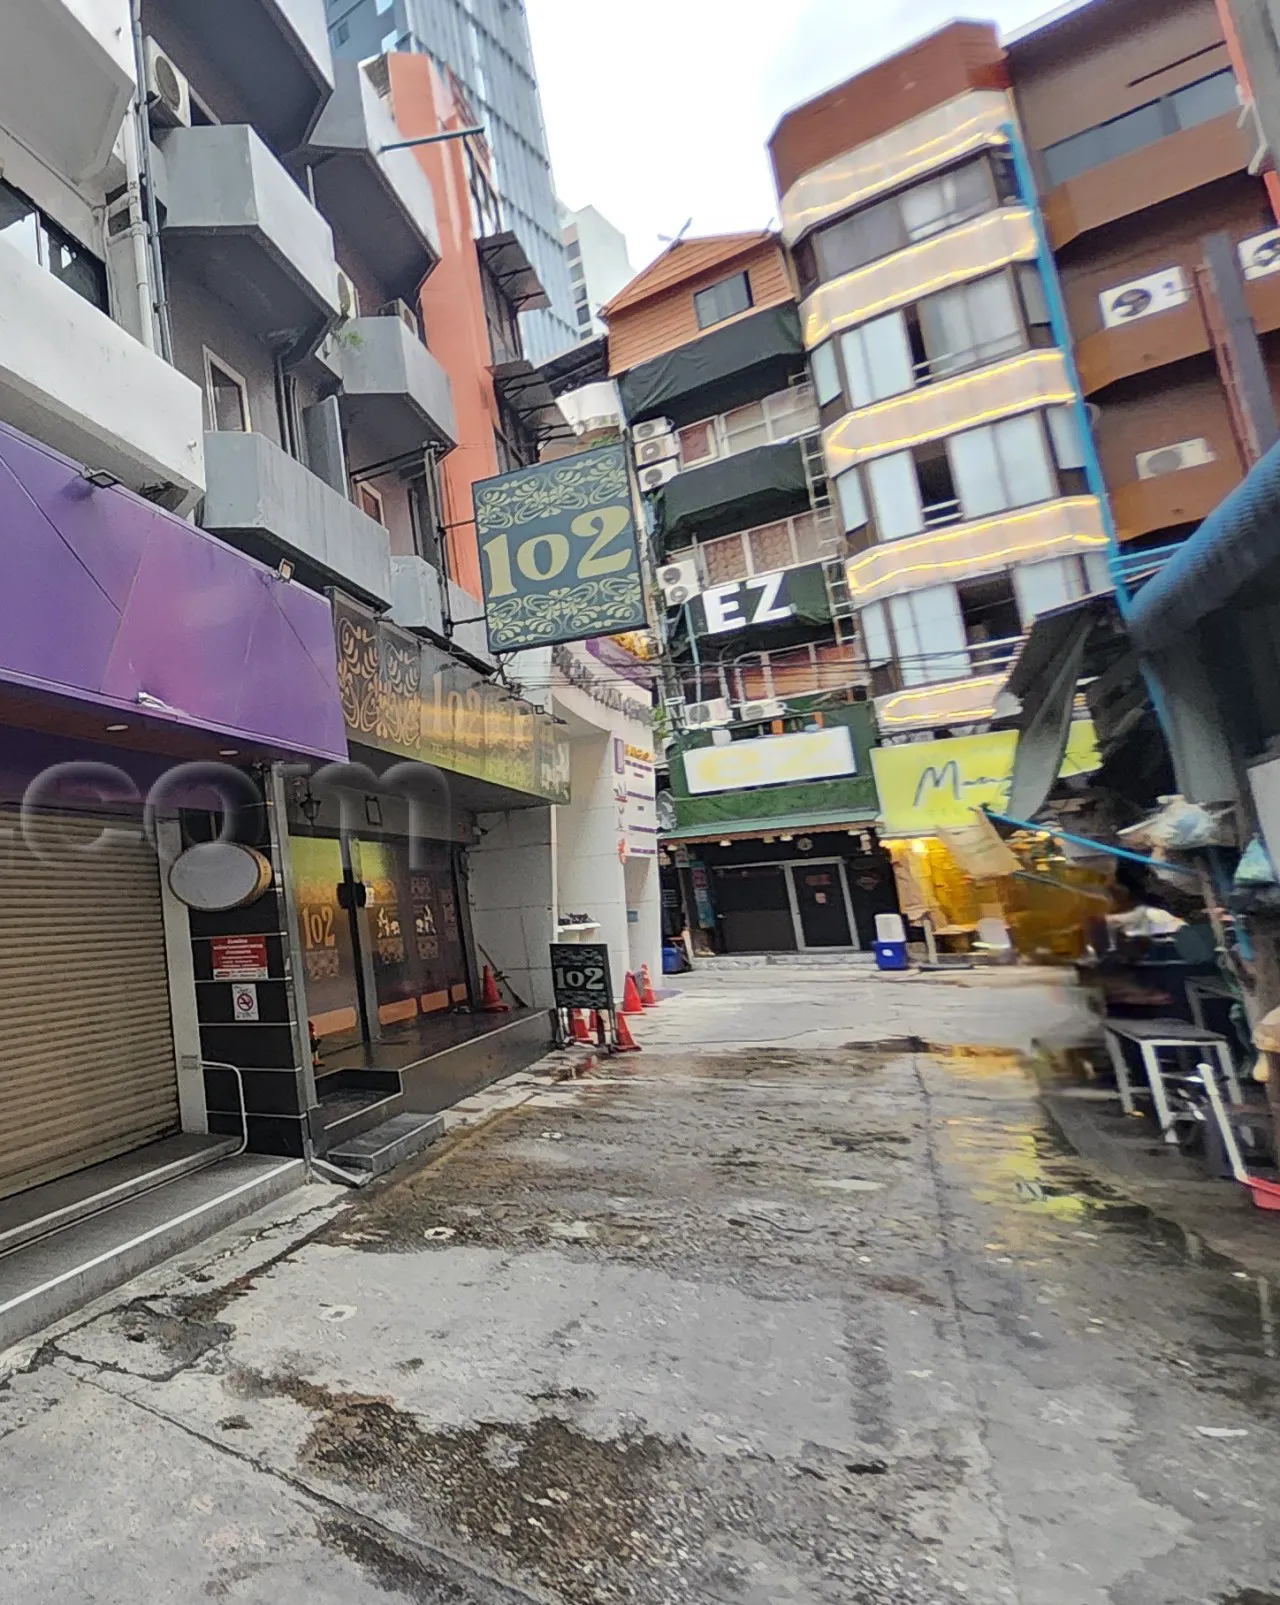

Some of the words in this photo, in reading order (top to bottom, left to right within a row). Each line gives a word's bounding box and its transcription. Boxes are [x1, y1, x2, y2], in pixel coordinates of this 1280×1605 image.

[482, 505, 632, 599] 102
[702, 571, 797, 634] EZ
[302, 906, 336, 949] 102
[555, 967, 605, 990] 102
